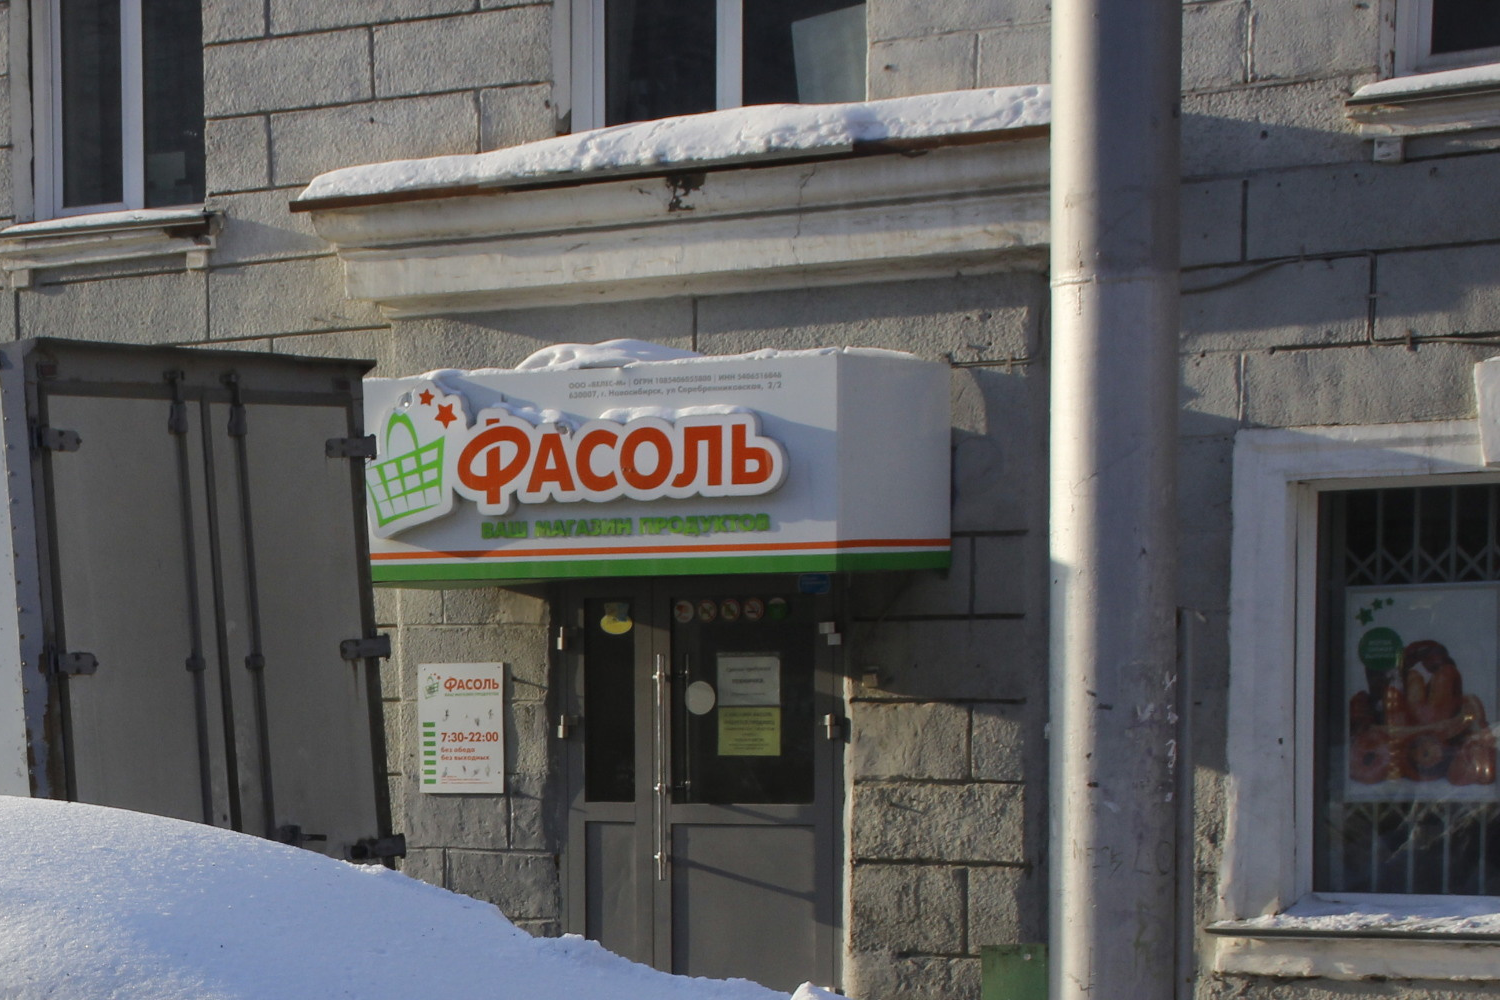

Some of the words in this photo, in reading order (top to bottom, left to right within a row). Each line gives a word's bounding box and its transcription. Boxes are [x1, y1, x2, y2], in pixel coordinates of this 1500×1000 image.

[609, 387, 664, 397] Новосибирск,
[457, 418, 774, 505] ФАСОЛЬ
[481, 521, 528, 539] ВАШ
[534, 517, 632, 536] МАГАЗИН
[639, 513, 771, 537] ПРОДУКТОВ
[444, 676, 500, 692] ФАСОЛЬ
[441, 731, 499, 742] 7:30-22:00
